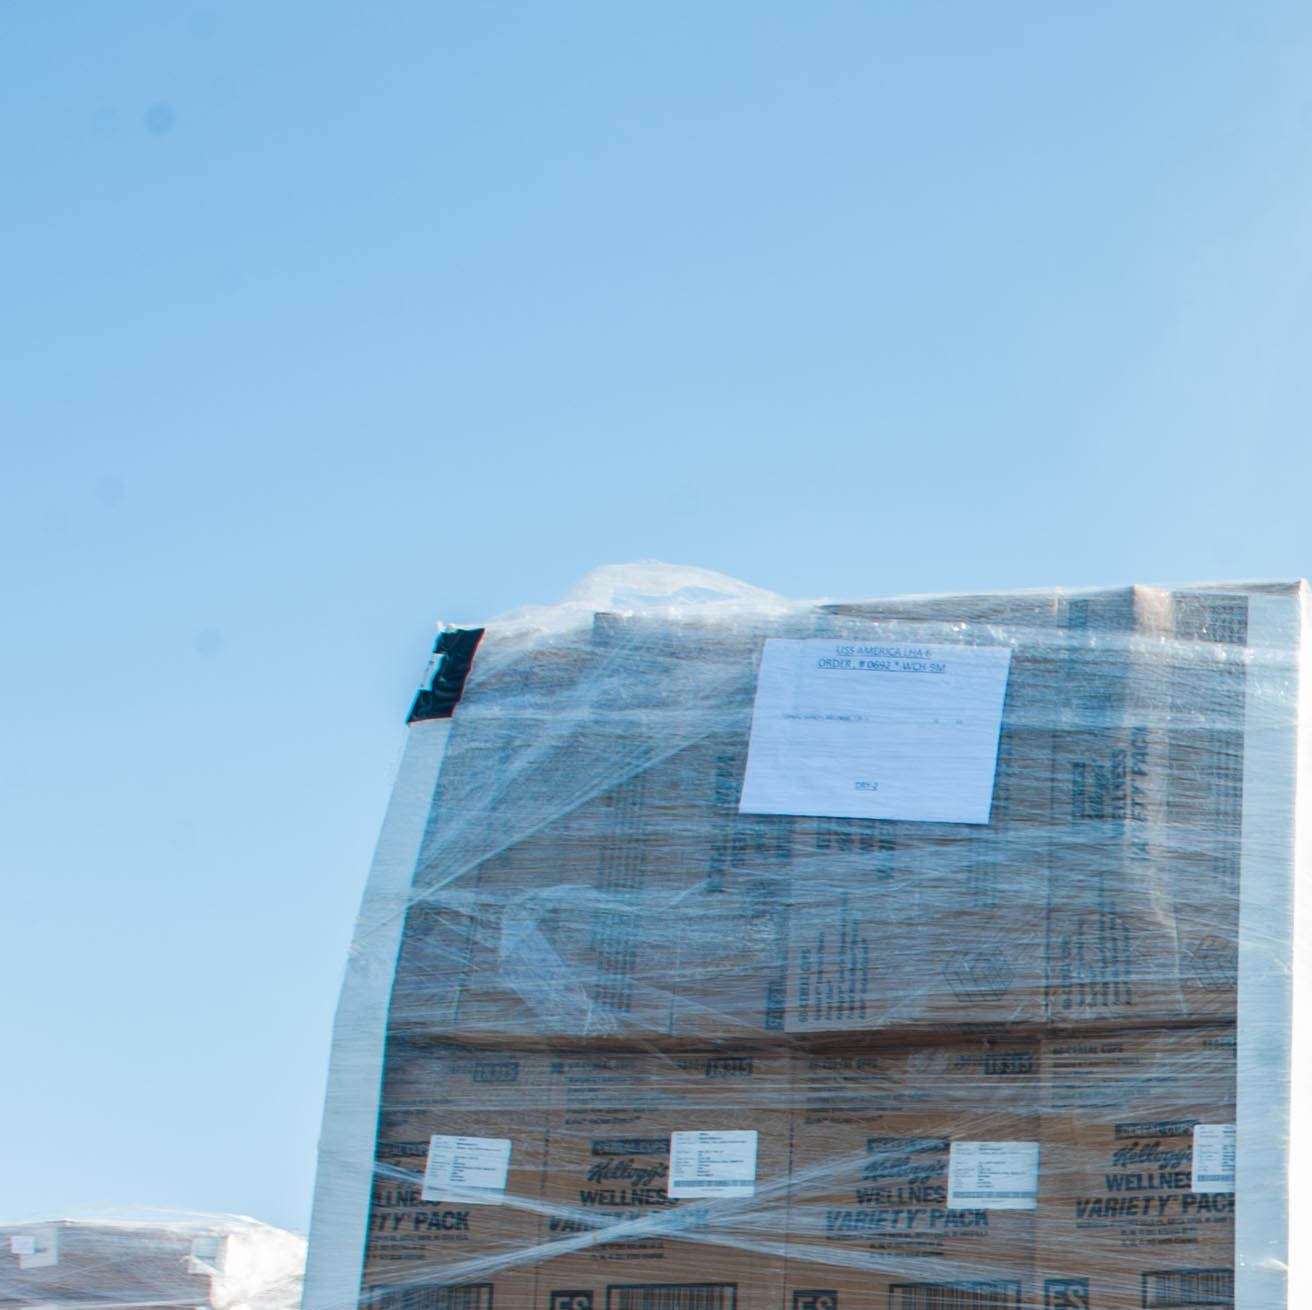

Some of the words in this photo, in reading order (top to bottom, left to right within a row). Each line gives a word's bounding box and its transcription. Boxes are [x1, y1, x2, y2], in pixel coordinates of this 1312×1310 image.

[856, 646, 901, 658] AMERICA
[928, 1207, 989, 1229] PACK
[1075, 1196, 1169, 1219] VARIETY
[413, 1210, 470, 1231] PACK
